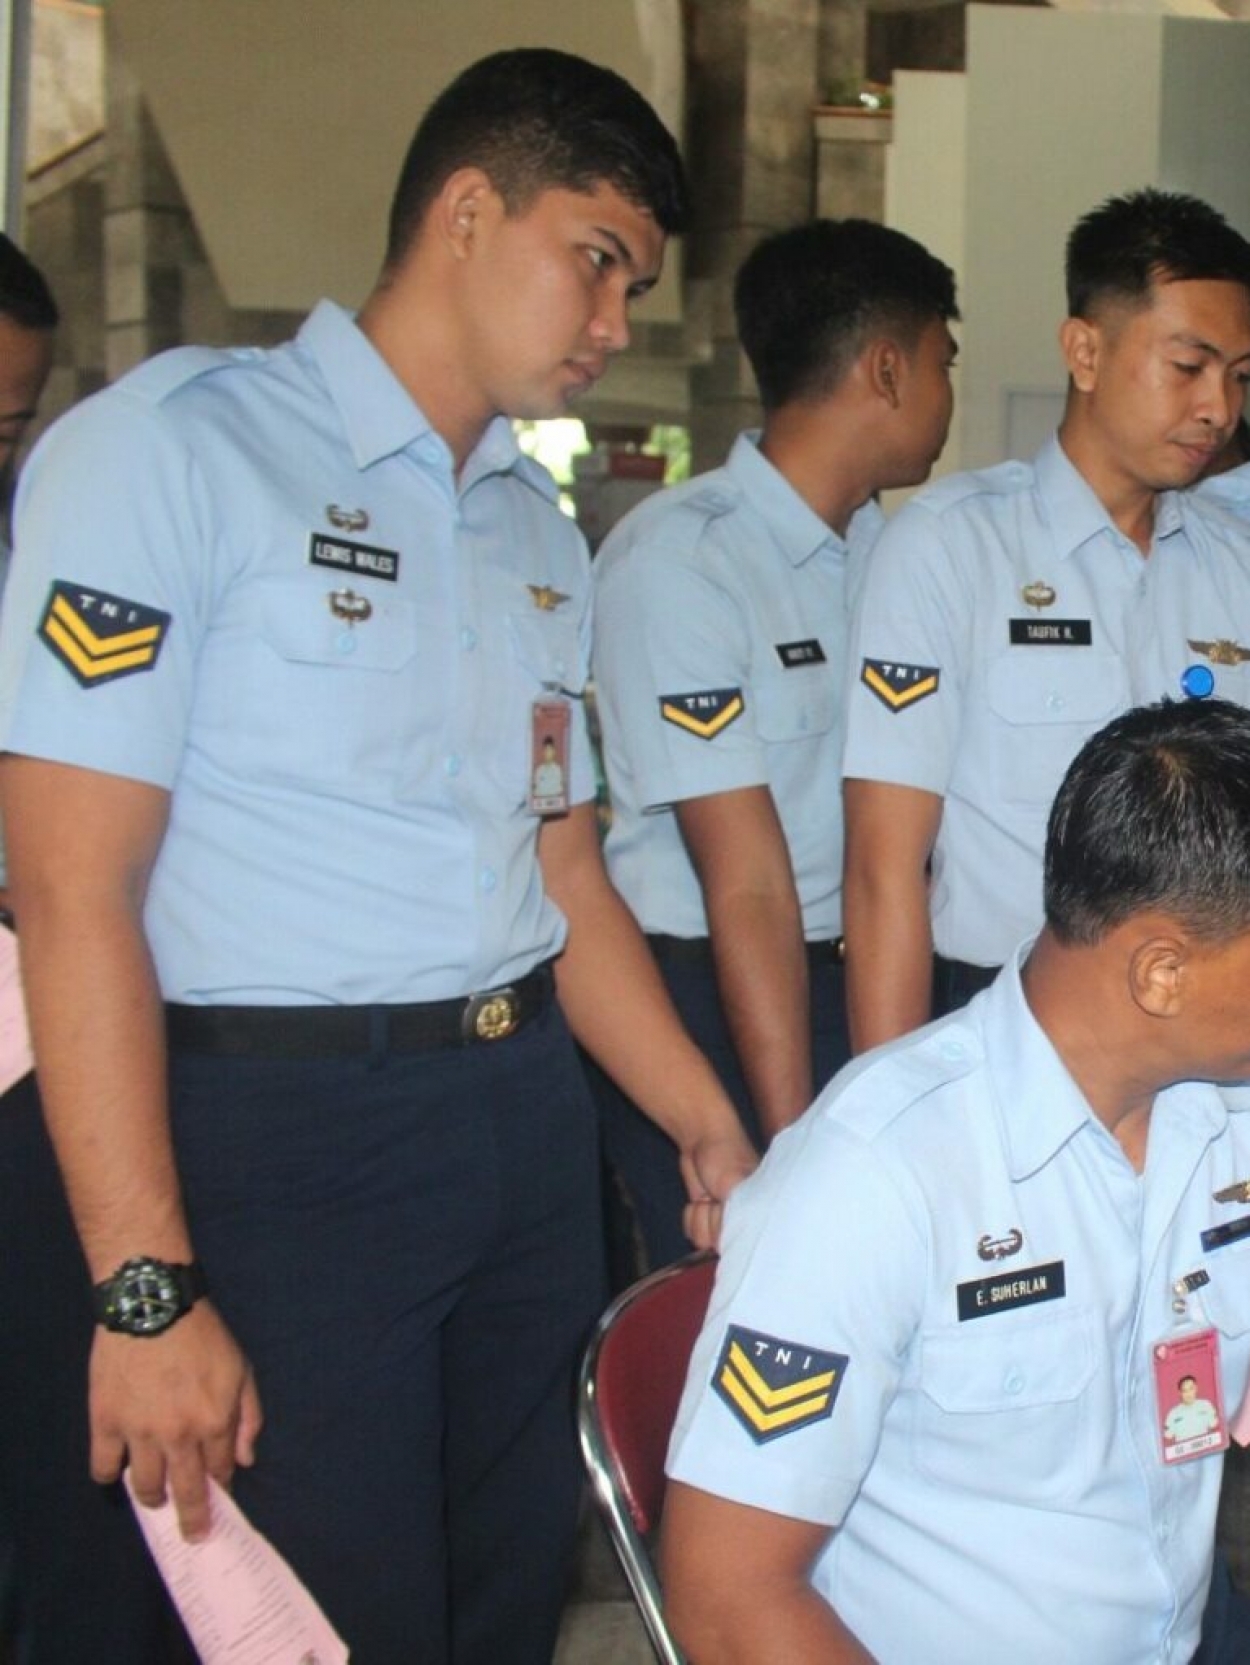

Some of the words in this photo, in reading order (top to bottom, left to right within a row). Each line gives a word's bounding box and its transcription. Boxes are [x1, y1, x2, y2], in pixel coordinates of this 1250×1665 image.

[79, 593, 138, 623] TNI
[881, 664, 920, 680] TNI
[685, 696, 718, 710] TNI
[976, 1289, 988, 1307] E.
[990, 1275, 1048, 1303] SUHERLAN
[755, 1340, 812, 1370] TNI
